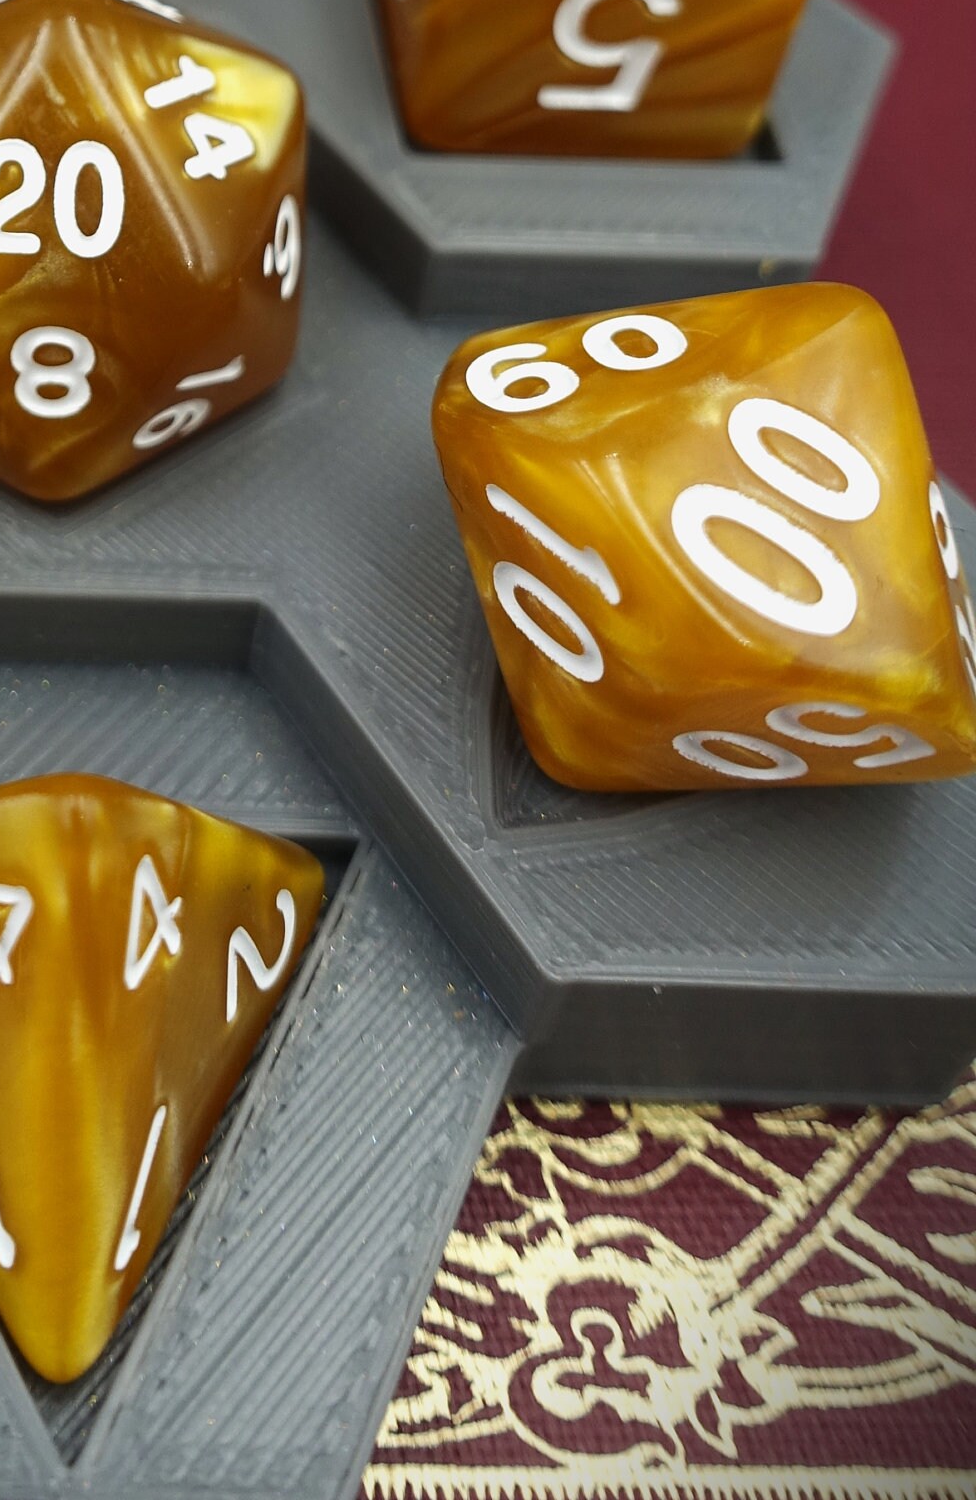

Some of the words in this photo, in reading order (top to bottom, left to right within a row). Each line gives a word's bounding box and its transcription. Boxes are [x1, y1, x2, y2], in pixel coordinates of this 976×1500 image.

[143, 56, 255, 181] 14
[11, 327, 95, 417] 8
[466, 315, 688, 412] 60
[486, 484, 621, 683] 10
[671, 398, 880, 636] 00
[672, 703, 934, 780] 50
[125, 856, 181, 989] 4
[226, 889, 295, 1023] 2
[115, 1106, 166, 1270] 1
